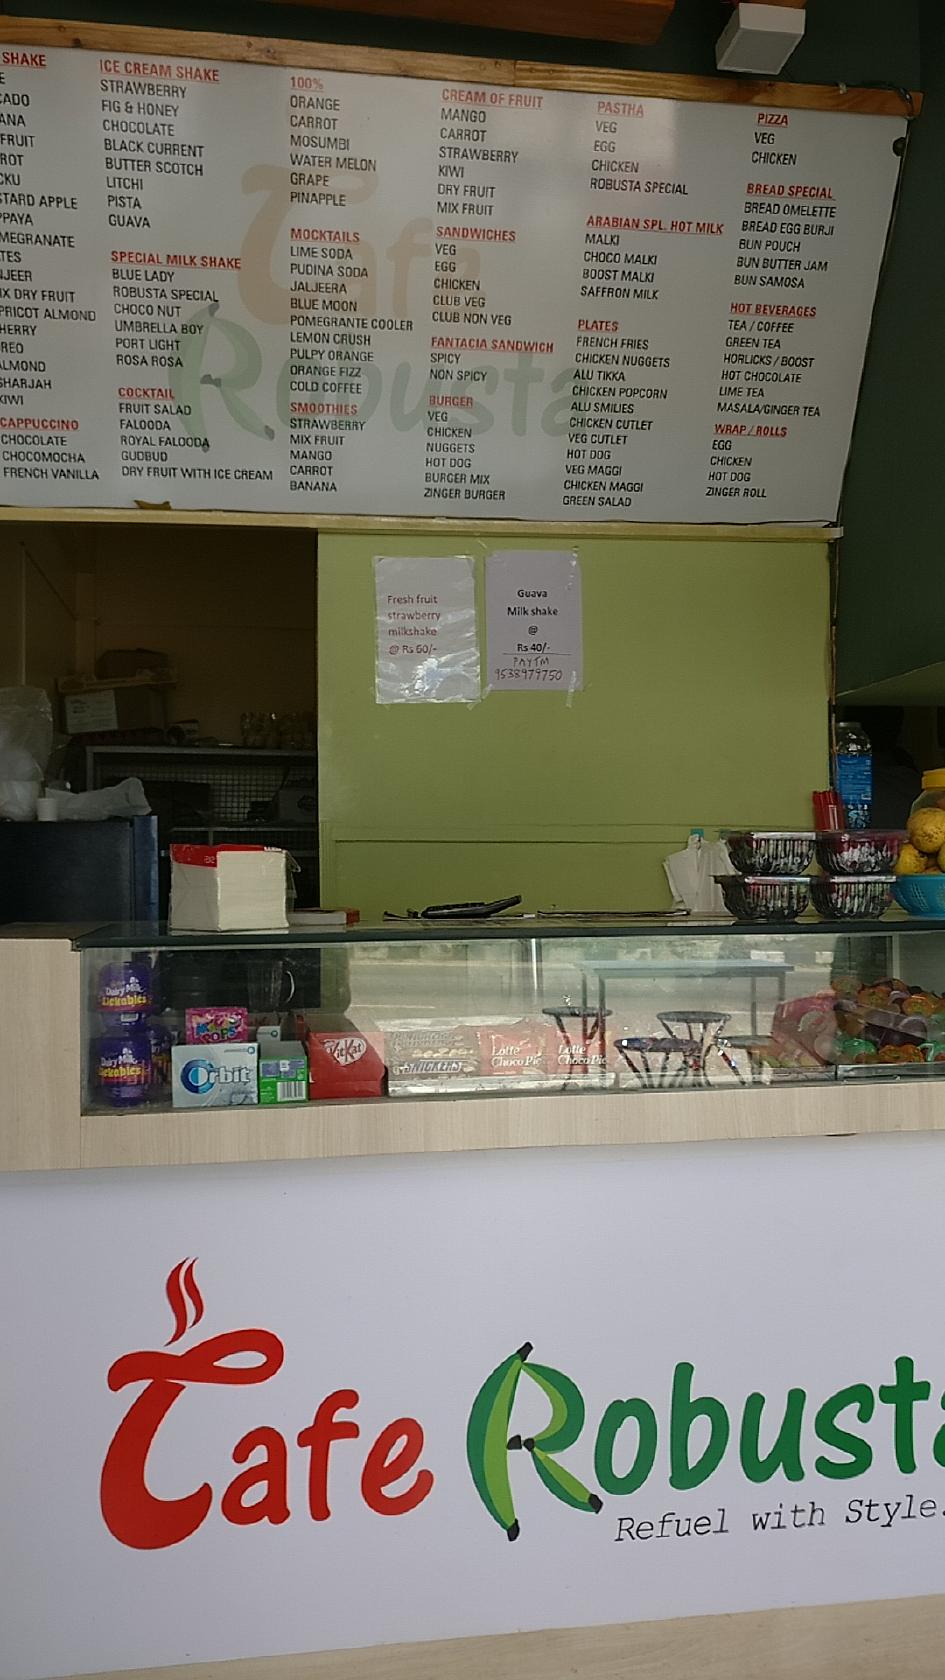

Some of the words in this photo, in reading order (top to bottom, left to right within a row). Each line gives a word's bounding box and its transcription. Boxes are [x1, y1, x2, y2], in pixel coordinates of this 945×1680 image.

[2, 52, 46, 69] SHAKE
[100, 59, 120, 75] ICE
[124, 61, 171, 80] CREAM
[176, 65, 219, 83] SHAKE
[101, 78, 186, 99] STRAWBERRY
[290, 76, 323, 89] 100%
[442, 88, 486, 105] CREAM
[490, 92, 504, 105] OF
[509, 94, 543, 108] FRUIT
[598, 101, 644, 116] PASTHA
[290, 114, 338, 131] CARROT
[596, 120, 617, 134] VEG
[758, 112, 788, 129] PIZZA
[0, 132, 34, 148] FRUIT
[440, 127, 487, 143] CARROT
[755, 131, 775, 145] VEG
[104, 137, 144, 153] BLACK
[147, 141, 204, 158] CURRENT
[105, 156, 151, 173] BUTTER
[156, 160, 203, 177] SCOTCH
[290, 152, 332, 169] WATER
[336, 156, 376, 172] MELON
[591, 158, 639, 174] CHICKEN
[438, 164, 464, 179] KIWI
[106, 175, 143, 191] LITCHI
[290, 190, 346, 207] PINAPPLE
[747, 182, 786, 199] BREAD
[788, 184, 834, 202] SPECIAL
[437, 200, 459, 214] MIX
[462, 202, 493, 216] FRUIT
[744, 200, 780, 215] BREAD
[783, 203, 836, 219] OMELETTE
[108, 213, 150, 229] GUAVA
[587, 214, 639, 232] ARABIAN
[643, 218, 666, 233] SPL.
[671, 219, 692, 235] HOT
[696, 221, 724, 236] MILK
[290, 227, 360, 245] MOCKTAILS
[437, 226, 515, 243] SANDWICHES
[585, 232, 620, 247] MALKI
[739, 238, 762, 251] BUN
[765, 239, 801, 253] POUCH
[111, 250, 162, 266] SPECIAL
[166, 253, 197, 269] MILK
[201, 255, 241, 271] SHAKE
[435, 260, 456, 274] EGG
[112, 267, 141, 282] BLUE
[144, 269, 174, 284] LADY
[290, 262, 333, 277] PUDINA
[337, 264, 368, 279] SODA
[583, 267, 619, 282] BOOST
[621, 269, 654, 284] MALKI
[734, 274, 757, 286] BUN
[760, 275, 804, 289] SAMOSA
[113, 284, 167, 300] ROBUSTA
[171, 288, 219, 306] SPECIAL
[433, 294, 460, 307] CLUB
[465, 295, 485, 309] VEG
[290, 296, 318, 311] BLUE
[322, 298, 357, 313] MOON
[731, 302, 752, 316] HOT
[755, 303, 816, 319] BEVERAGES
[115, 319, 178, 335] UMBRELLA
[181, 323, 203, 336] BOY
[578, 318, 618, 333] PLATES
[116, 337, 144, 350] PORT
[149, 338, 181, 352] LIGHT
[290, 331, 330, 345] LEMON
[333, 332, 371, 347] CRUSH
[431, 336, 487, 350] FANTACIA
[492, 338, 553, 354] SANDWICH
[577, 335, 618, 349] FRENCH
[620, 338, 648, 351] FRIES
[116, 353, 148, 367] ROSA
[151, 354, 183, 369] ROSA
[430, 352, 461, 365] SPICY
[290, 363, 335, 379] ORANGE
[339, 366, 361, 378] FIZZ
[573, 368, 593, 384] ALU
[598, 369, 625, 383] TIKKA
[118, 387, 175, 402] COCKTAIL
[719, 385, 743, 397] LIME
[747, 386, 764, 398] TEA
[290, 401, 357, 417] SMOOTHIES
[429, 394, 473, 409] BURGER
[571, 400, 591, 416] ALU
[594, 401, 634, 415] SMILIES
[0, 416, 79, 432] CAPPUCCINO
[290, 416, 366, 431] STRAWBERRY
[427, 409, 448, 423] VEG
[120, 418, 171, 432] FALOODA
[715, 423, 746, 437] WRAP
[755, 425, 787, 439] ROLLS
[1, 433, 66, 447] CHOCOLATE
[568, 431, 587, 445] VEG
[591, 433, 627, 446] CUTLET
[712, 438, 732, 452] EGG
[290, 449, 332, 462] MANGO
[426, 442, 475, 454] NUGGETS
[121, 450, 168, 463] GUDBUD
[3, 466, 48, 480] FRENCH
[51, 467, 99, 481] VANILLA
[565, 464, 585, 475] VEG
[588, 464, 622, 477] MAGGI
[708, 470, 728, 482] HOT
[730, 471, 751, 483] DOG
[290, 479, 337, 492] BANANA
[425, 472, 466, 484] BURGER
[470, 473, 490, 486] MIX
[563, 494, 595, 507] GREEN
[598, 496, 632, 508] SALAD
[387, 594, 414, 604] Fresh
[416, 594, 438, 604] fruit
[517, 589, 548, 598] Guava
[387, 611, 440, 621] strawberry
[507, 606, 529, 616] Milk
[531, 606, 559, 616] shake
[388, 627, 438, 636] milkshake
[528, 625, 538, 635] @
[389, 645, 399, 655] @
[402, 645, 414, 654] Rs
[416, 644, 437, 655] 60/-
[517, 643, 529, 652] Rs
[530, 642, 550, 653] 40/-
[513, 656, 549, 667] PAYTM
[491, 1057, 524, 1066] Choco
[525, 1055, 542, 1065] Pie
[181, 1059, 251, 1094] Orbit
[100, 1328, 434, 1549] Cafe
[466, 1340, 945, 1542] Robust
[614, 1508, 729, 1542] Refuel
[752, 1501, 825, 1531] with
